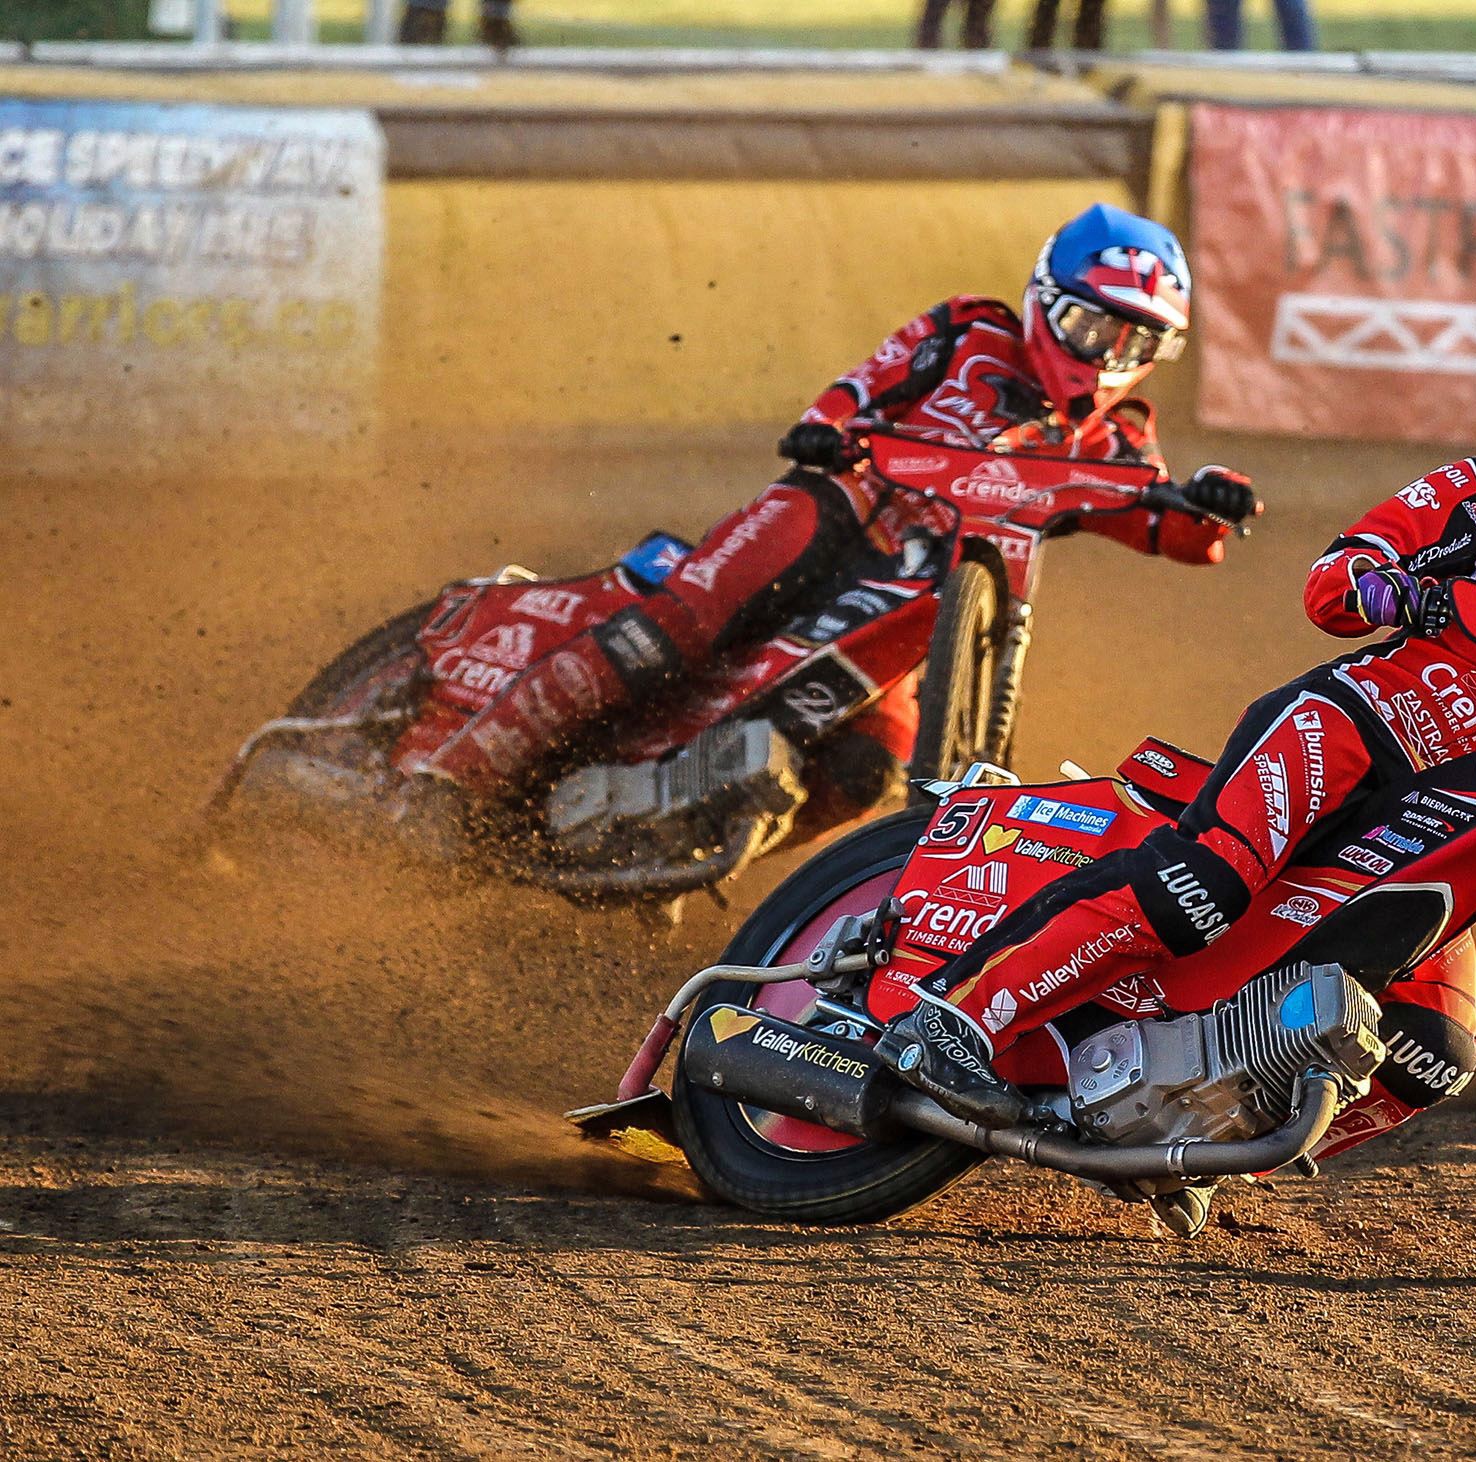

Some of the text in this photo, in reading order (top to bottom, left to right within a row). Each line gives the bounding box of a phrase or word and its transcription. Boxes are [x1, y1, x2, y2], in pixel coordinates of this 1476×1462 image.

[949, 476, 1056, 508] Crendon
[1253, 753, 1279, 829] SPEEDWAY
[930, 803, 978, 845] 5
[1035, 802, 1110, 828] Ice Machines
[1014, 837, 1095, 868] ValleyKitche
[1157, 861, 1223, 929] LUCAS
[905, 928, 946, 946] TIMBER
[752, 1025, 870, 1080] ValleyKitchens
[1385, 1030, 1459, 1090] LUCAS
